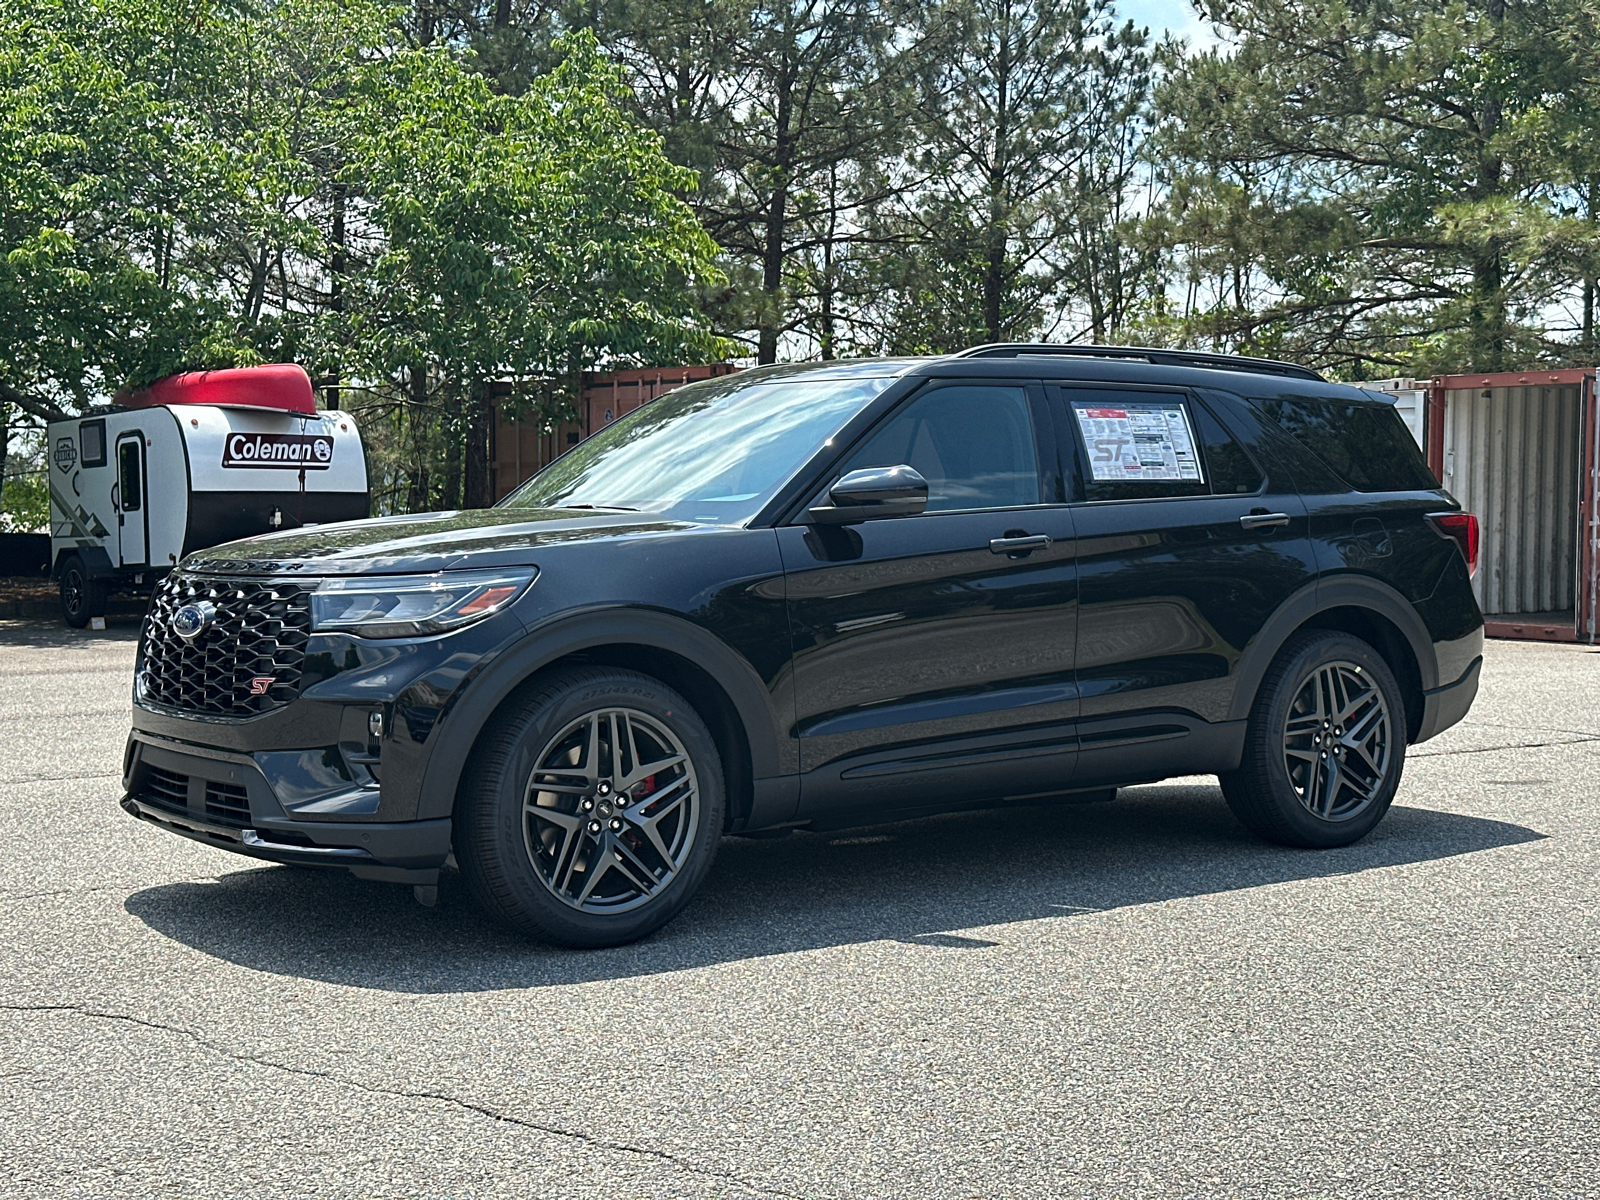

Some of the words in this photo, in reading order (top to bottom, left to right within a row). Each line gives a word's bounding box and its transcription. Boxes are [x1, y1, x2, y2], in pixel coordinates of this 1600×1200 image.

[229, 434, 312, 460] Coleman
[1093, 439, 1130, 462] ST
[250, 677, 276, 695] ST
[582, 687, 628, 701] 275/45
[503, 815, 521, 870] ZERO
